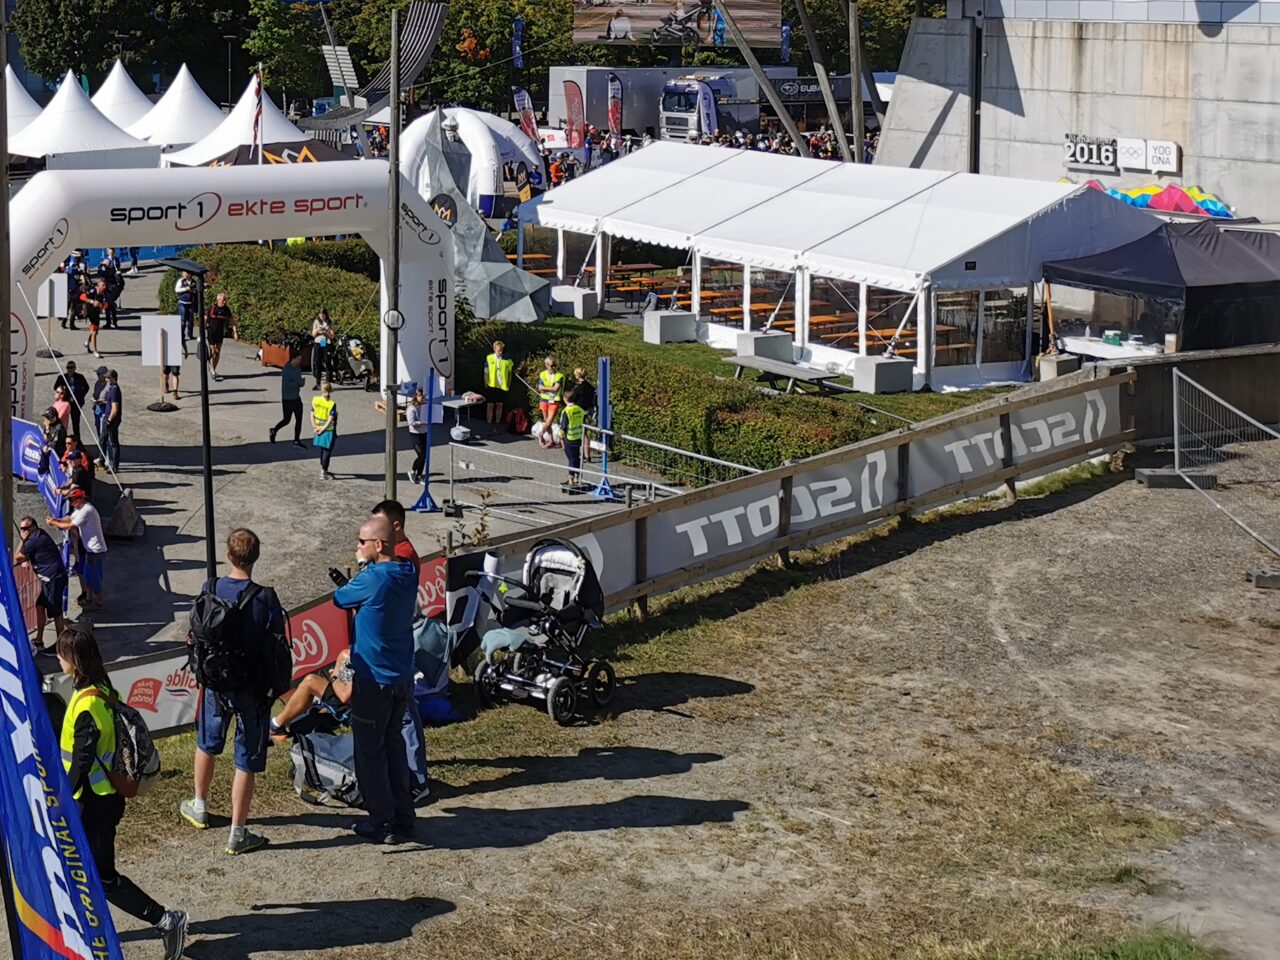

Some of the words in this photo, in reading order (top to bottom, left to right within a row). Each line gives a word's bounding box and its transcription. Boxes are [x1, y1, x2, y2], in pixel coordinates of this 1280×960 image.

[1064, 142, 1114, 166] 2016
[1151, 156, 1171, 165] DNA
[1153, 146, 1171, 156] YOG
[110, 203, 187, 225] sport
[227, 198, 286, 216] ekte
[294, 193, 365, 218] sport
[400, 202, 429, 234] sport
[22, 237, 55, 275] sport
[436, 278, 448, 347] sport
[51, 816, 99, 928] ORIGINAL
